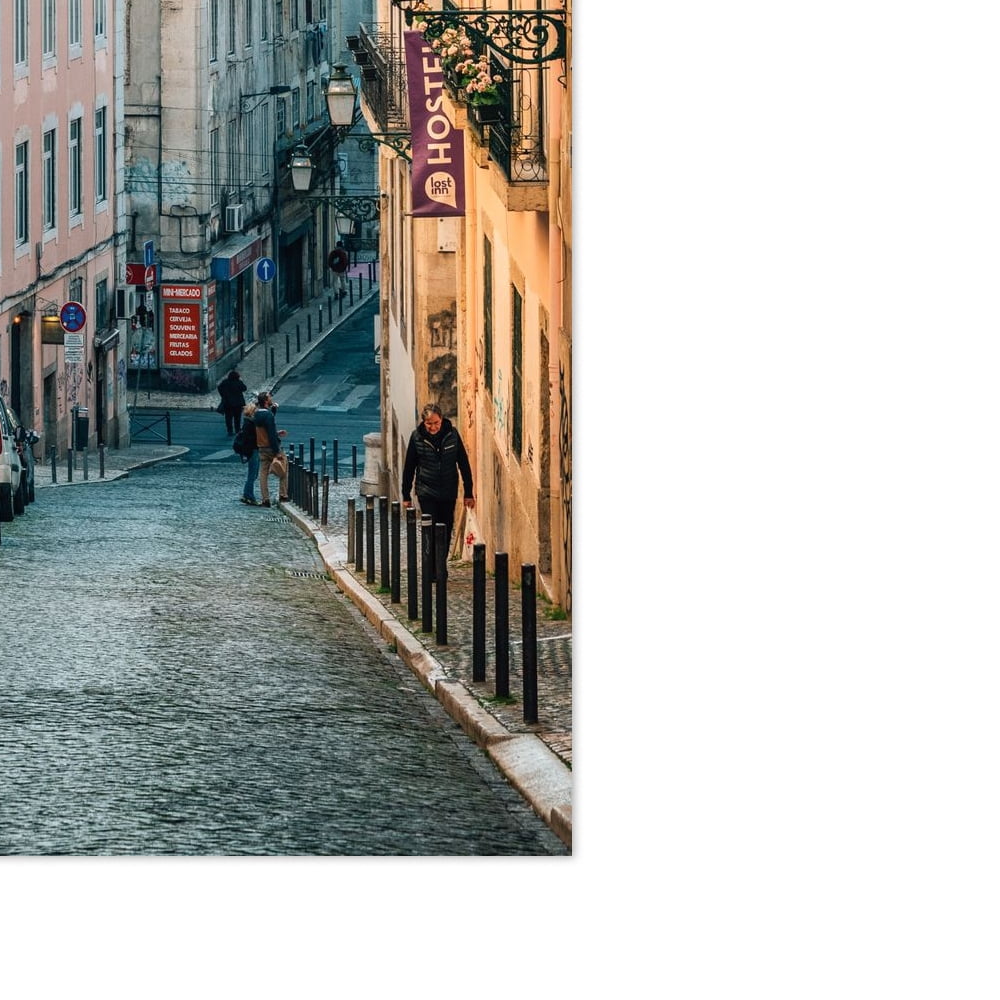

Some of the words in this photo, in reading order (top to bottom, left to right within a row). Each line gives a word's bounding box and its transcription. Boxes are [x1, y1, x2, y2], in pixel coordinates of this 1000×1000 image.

[422, 46, 452, 164] HOSTE
[430, 176, 452, 188] lost
[431, 186, 449, 195] inn
[163, 287, 201, 297] MINI-MERCADO
